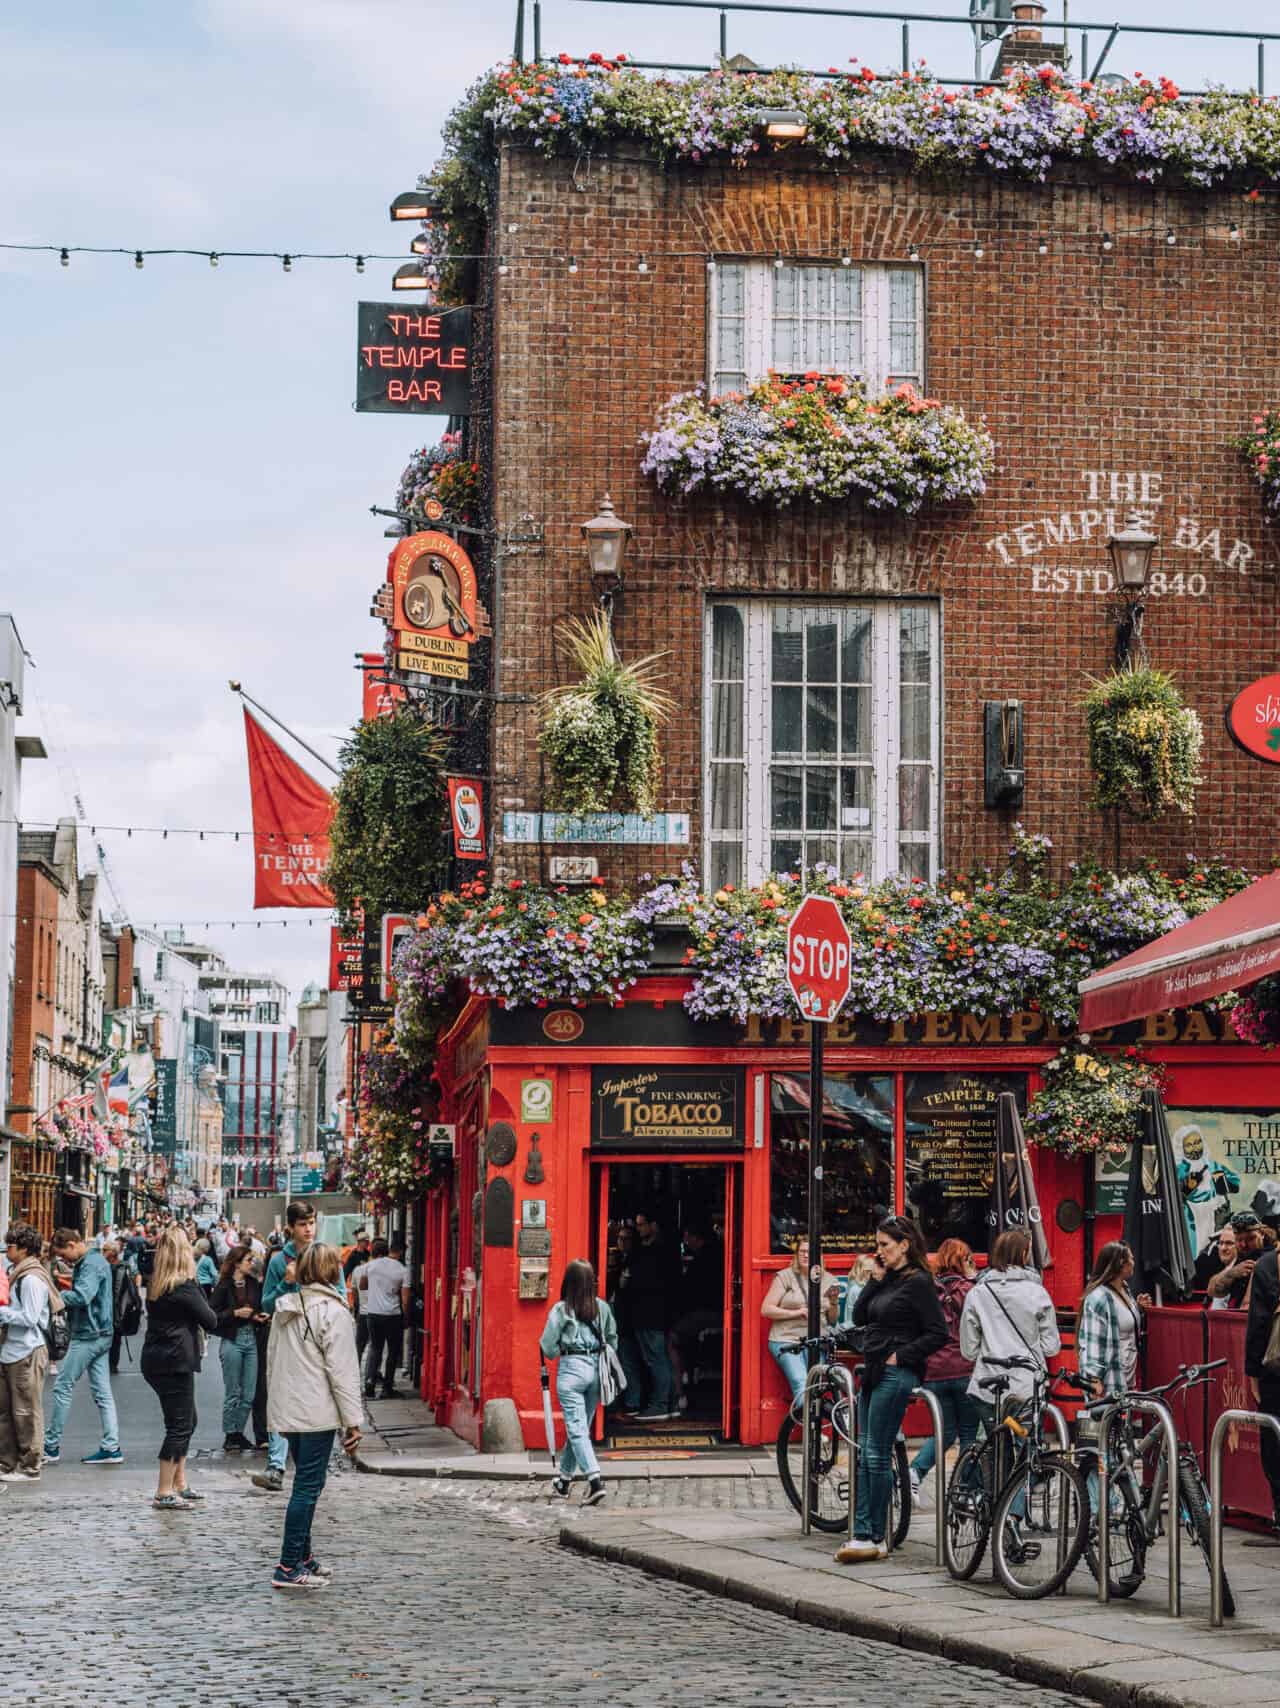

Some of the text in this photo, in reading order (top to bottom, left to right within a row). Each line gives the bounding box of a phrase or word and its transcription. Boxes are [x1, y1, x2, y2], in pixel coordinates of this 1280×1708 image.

[388, 315, 441, 338] THE
[361, 346, 467, 369] TEMPLE
[388, 379, 441, 401] BAR
[1082, 471, 1162, 502] THE
[1171, 516, 1256, 575] BAR
[1031, 566, 1207, 597] ESTD 840
[415, 636, 456, 653] DUBLIN
[406, 655, 466, 676] LIVE MUSIC
[791, 933, 849, 982] STOP
[550, 1015, 576, 1034] 48
[740, 1011, 858, 1043] THE
[597, 1072, 658, 1097] Importers
[961, 1078, 978, 1088] The
[651, 1091, 721, 1101] FINE SMOKING
[923, 1089, 982, 1107] TEMPLE
[614, 1096, 722, 1133] TOBACCO
[635, 1126, 731, 1136] Always in Stock
